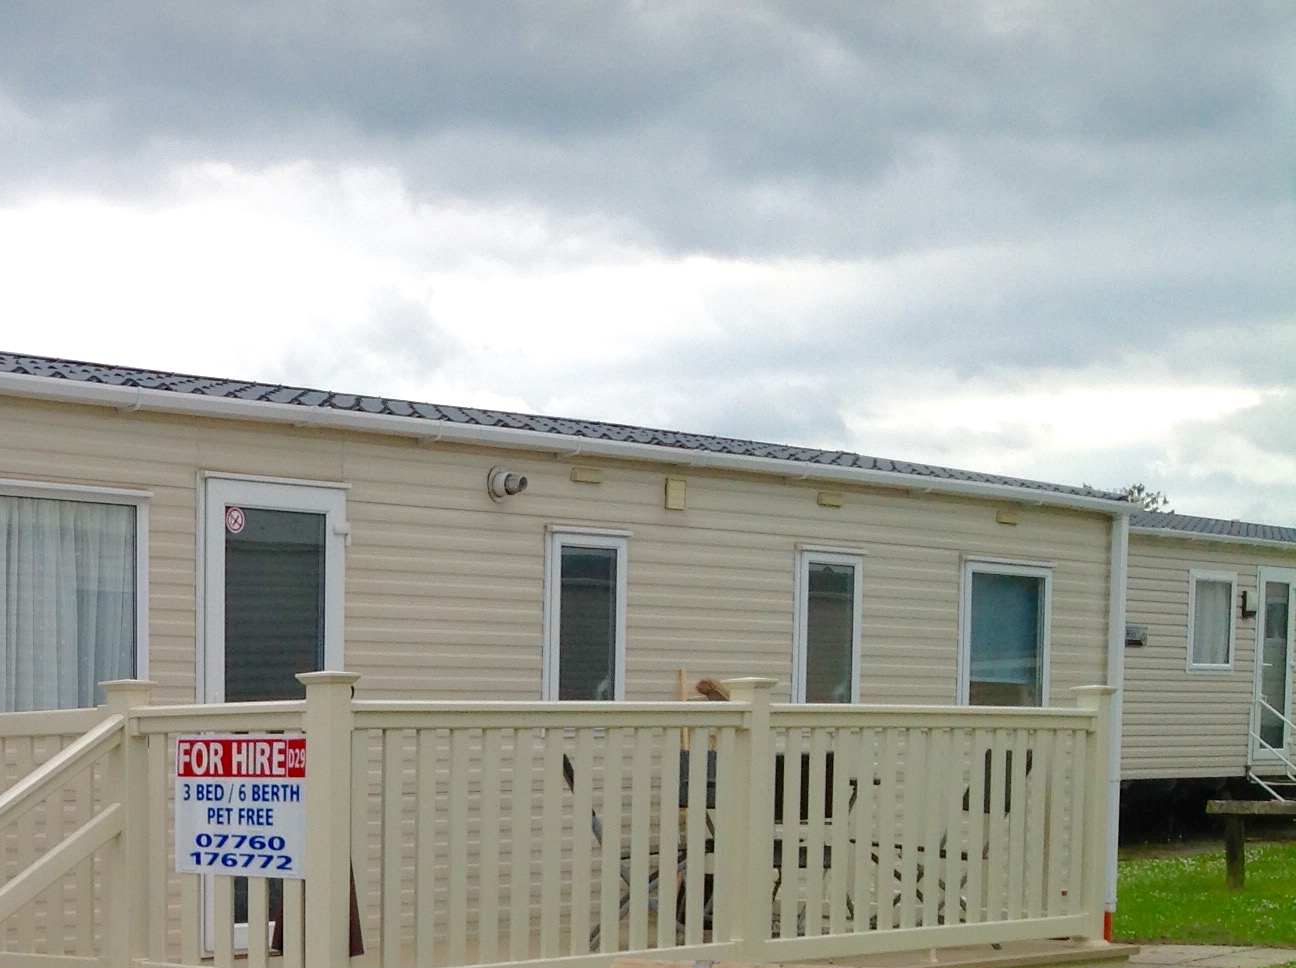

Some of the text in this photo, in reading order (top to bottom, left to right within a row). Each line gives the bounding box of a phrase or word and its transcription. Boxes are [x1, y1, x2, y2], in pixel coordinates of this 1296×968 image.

[178, 742, 286, 775] FOR HIRE
[288, 748, 306, 769] D29
[183, 783, 301, 804] 3 BED / 6 BERTH
[207, 807, 274, 826] PET FREE
[195, 833, 286, 851] 07760
[189, 851, 293, 871] 176772
